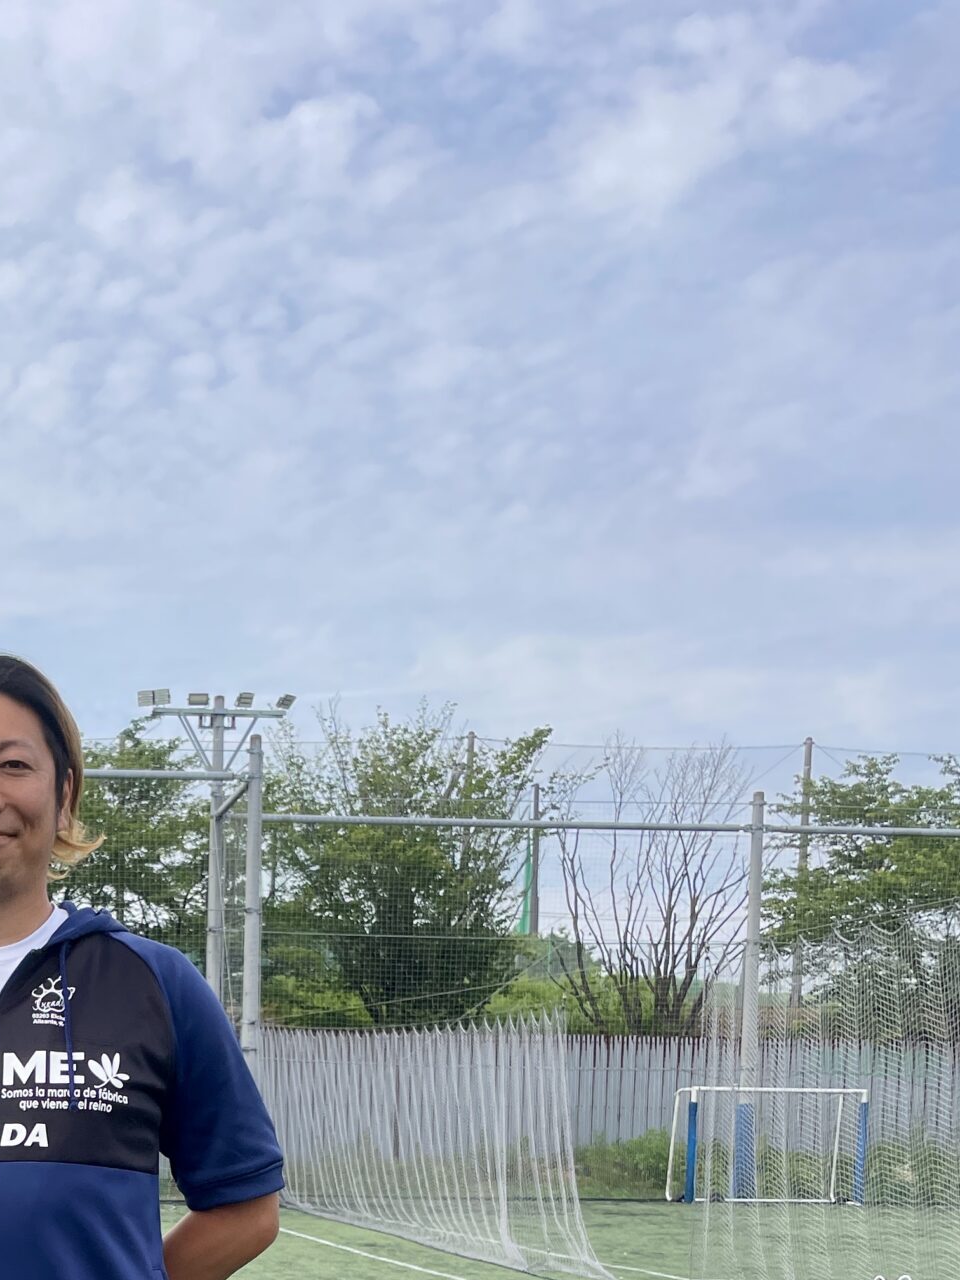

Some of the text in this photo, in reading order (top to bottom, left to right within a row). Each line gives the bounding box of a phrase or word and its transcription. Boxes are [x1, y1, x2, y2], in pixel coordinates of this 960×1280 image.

[2, 1050, 85, 1086] ME
[1, 1088, 34, 1099] Somos
[35, 1086, 46, 1098] la
[83, 1087, 97, 1099] de
[98, 1088, 129, 1105] fábrica
[19, 1100, 39, 1111] que
[41, 1098, 69, 1110] viene
[88, 1101, 113, 1113] reino
[0, 1123, 49, 1148] DA
